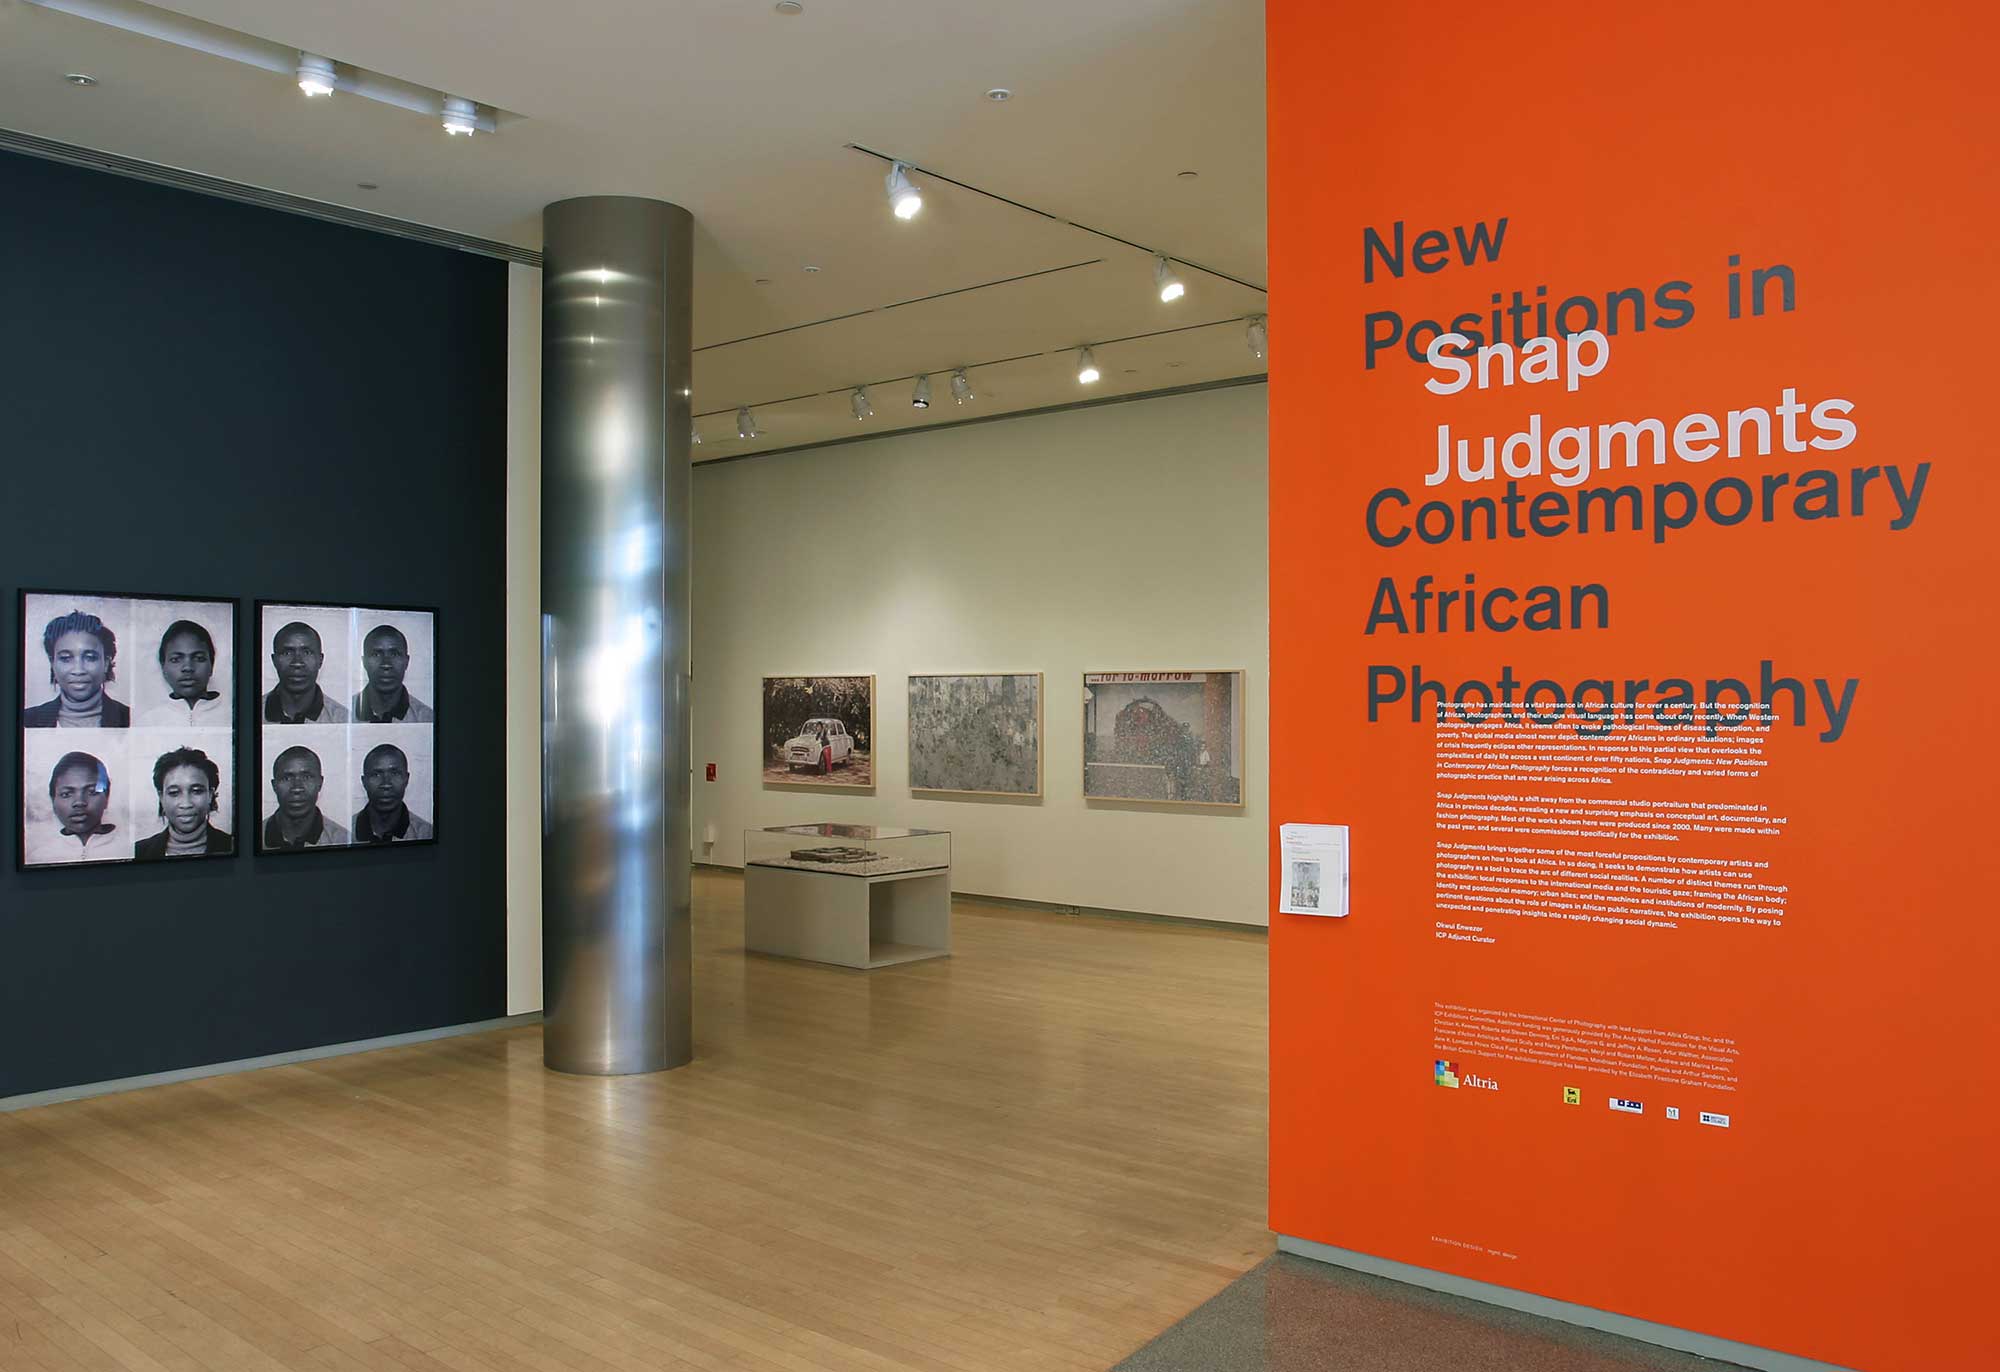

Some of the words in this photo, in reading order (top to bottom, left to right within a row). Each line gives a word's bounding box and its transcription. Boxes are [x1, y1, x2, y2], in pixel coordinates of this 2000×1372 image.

[1364, 217, 1508, 283] New
[1365, 281, 1695, 369] Positions
[1728, 254, 1795, 320] in
[1424, 329, 1610, 395] Snap
[1425, 387, 1857, 487] Judgments
[1366, 462, 1931, 548] Contemporary
[1364, 575, 1609, 635] African
[1367, 660, 1859, 743] Photography
[1437, 701, 1475, 709] Photography
[1728, 702, 1770, 710] recognition
[1437, 722, 1475, 730] photography
[1603, 724, 1645, 732] pathological
[1646, 724, 1672, 732] images
[1467, 712, 1512, 720] photographers
[1543, 712, 1565, 720] unique
[1587, 713, 1619, 721] language
[1678, 713, 1693, 721] only
[1461, 742, 1492, 750] frequently
[1493, 743, 1516, 751] eclipse
[1654, 746, 1676, 754] partial
[1437, 772, 1476, 781] photographic
[1477, 773, 1502, 781] practice
[1544, 775, 1566, 783] arising
[1437, 791, 1453, 800] Snap
[1453, 792, 1486, 801] Judgments
[1487, 793, 1518, 802] highlights
[1588, 797, 1628, 805] commercial
[1652, 800, 1690, 809] portraiture
[1707, 802, 1759, 812] predominated
[1447, 823, 1461, 831] past
[1531, 827, 1579, 836] commissioned
[1580, 829, 1618, 839] specifically
[1437, 842, 1452, 850] Snap
[1453, 843, 1486, 852] Judgments
[1487, 845, 1507, 853] brings
[1508, 846, 1535, 855] together
[1595, 851, 1622, 859] forceful
[1623, 853, 1666, 863] propositions
[1678, 856, 1728, 866] contemporary
[1729, 859, 1753, 867] artists
[1436, 902, 1471, 912] unexpected
[1485, 906, 1521, 916] penetrating
[1522, 909, 1548, 919] insights
[1568, 913, 1591, 922] rapidly
[1592, 914, 1624, 925] changing
[1625, 917, 1646, 925] social
[1448, 932, 1471, 942] Adjunct
[1472, 934, 1496, 943] Curator
[1463, 1074, 1498, 1090] Altria
